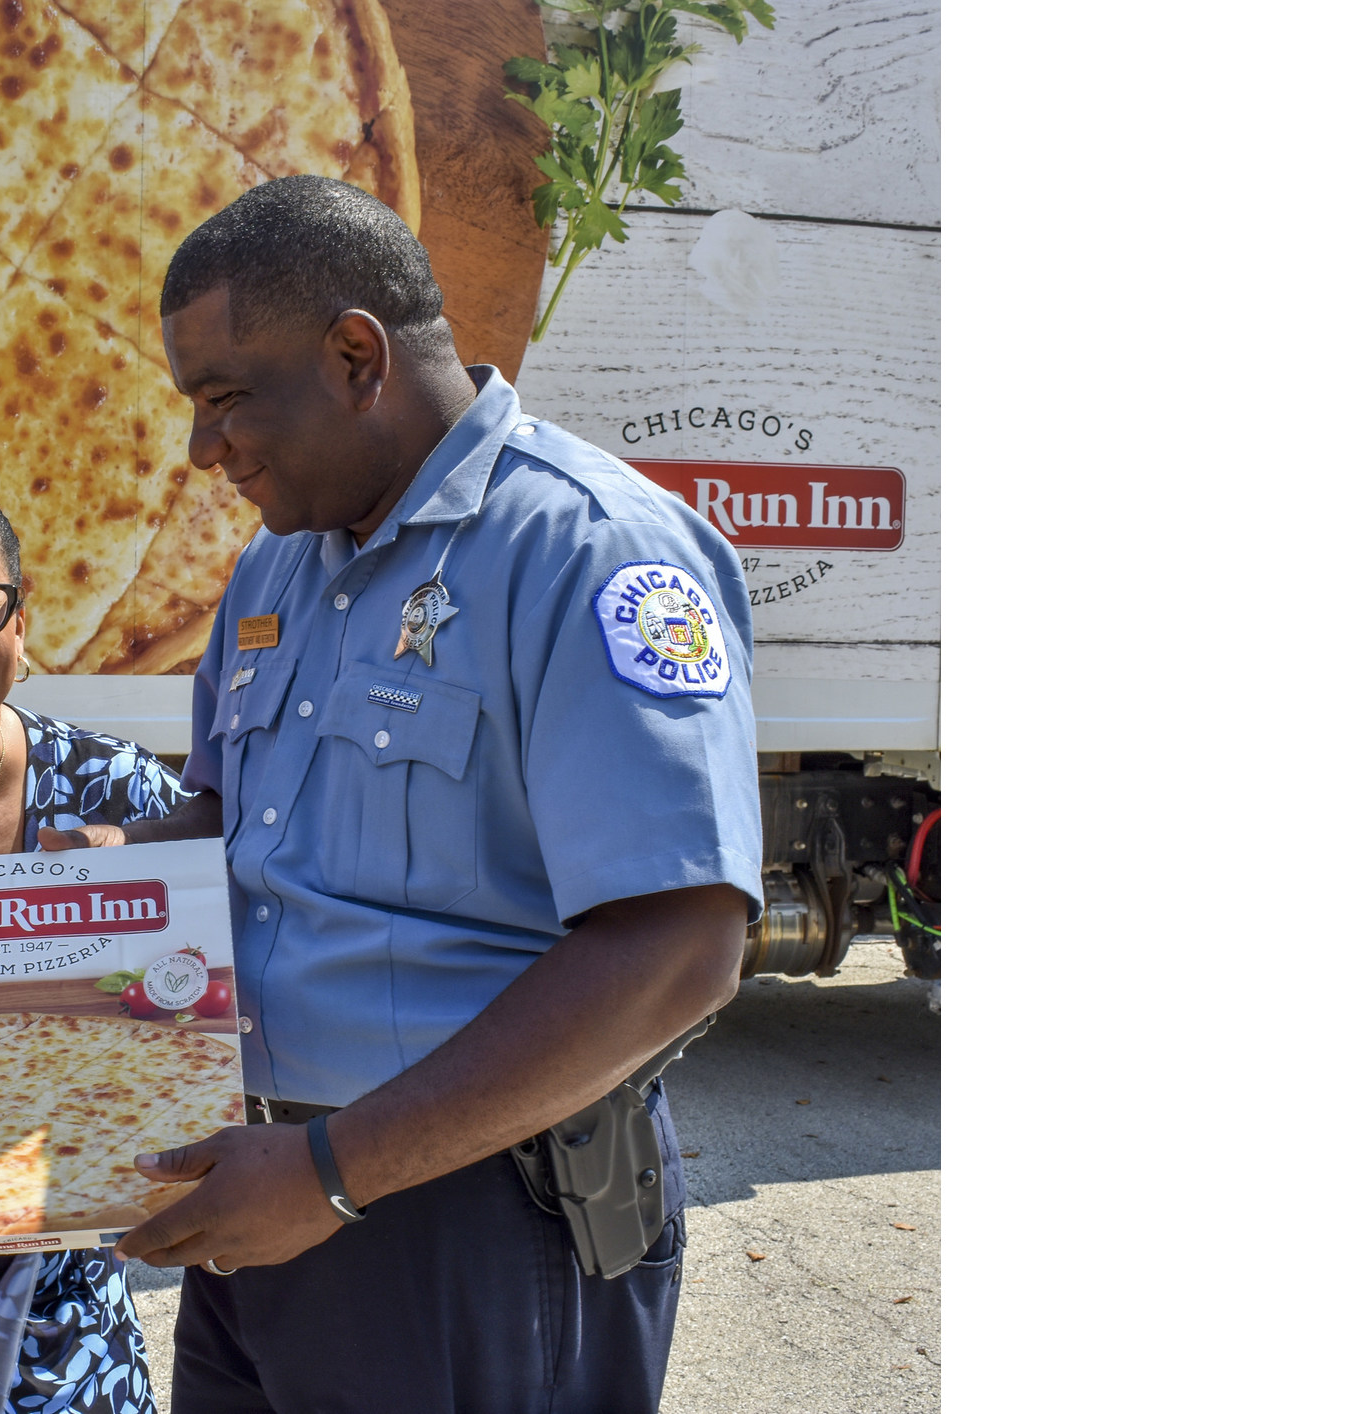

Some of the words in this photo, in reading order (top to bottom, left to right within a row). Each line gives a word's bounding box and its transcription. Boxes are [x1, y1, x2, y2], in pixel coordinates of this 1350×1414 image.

[622, 407, 814, 451] CHICAGO'S
[693, 477, 801, 536] Run
[807, 481, 893, 530] Inn
[742, 557, 761, 573] 47
[615, 570, 714, 625] CHICAGO
[749, 560, 834, 606] ZZERIA
[634, 646, 722, 684] POLICE
[88, 892, 160, 923] Inn
[20, 941, 54, 953] 1947
[24, 937, 112, 974] PIZZERIA
[152, 960, 168, 974] ALL
[147, 981, 158, 998] MADE
[156, 996, 174, 1006] FROM
[175, 986, 203, 1006] SCRATCH
[17, 1240, 39, 1248] Run
